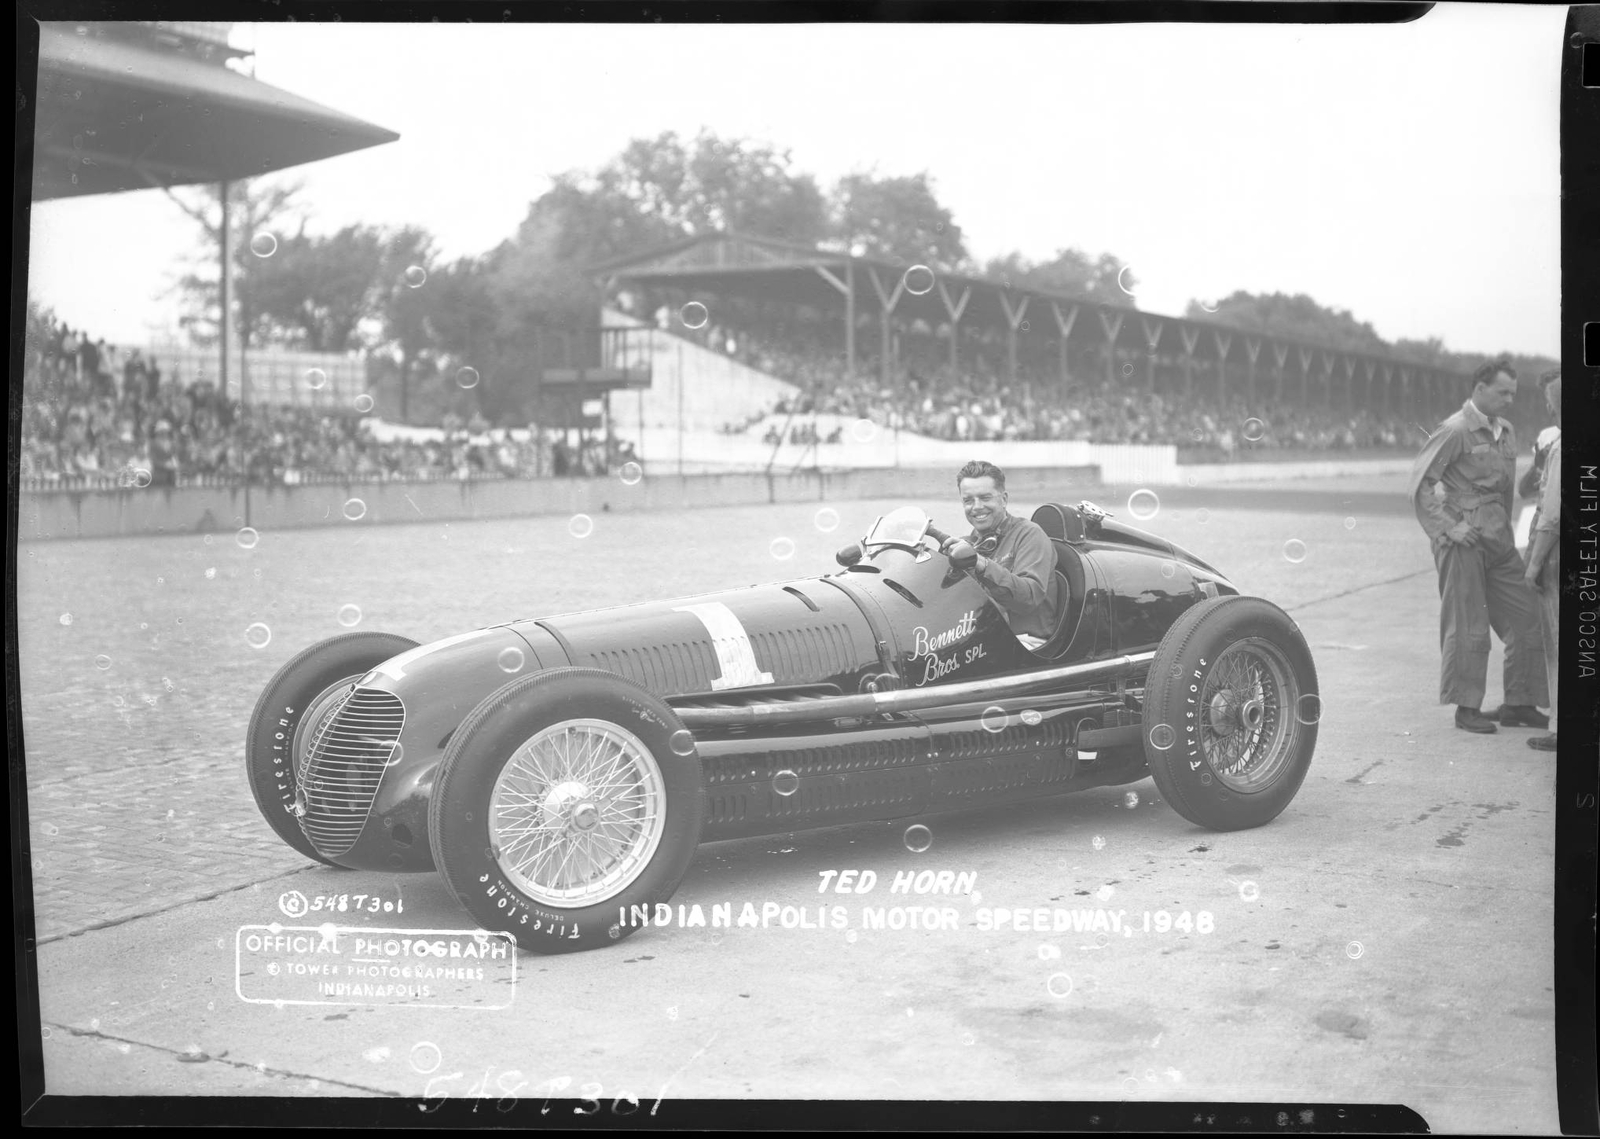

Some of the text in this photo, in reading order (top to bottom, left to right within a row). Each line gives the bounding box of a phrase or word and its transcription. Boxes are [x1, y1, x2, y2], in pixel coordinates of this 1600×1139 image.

[672, 602, 775, 691] 1
[907, 610, 977, 662] Bennett
[915, 652, 961, 687] Bros.
[1186, 658, 1207, 771] Firestone
[273, 706, 299, 814] Firestone
[479, 873, 581, 939] Firestone
